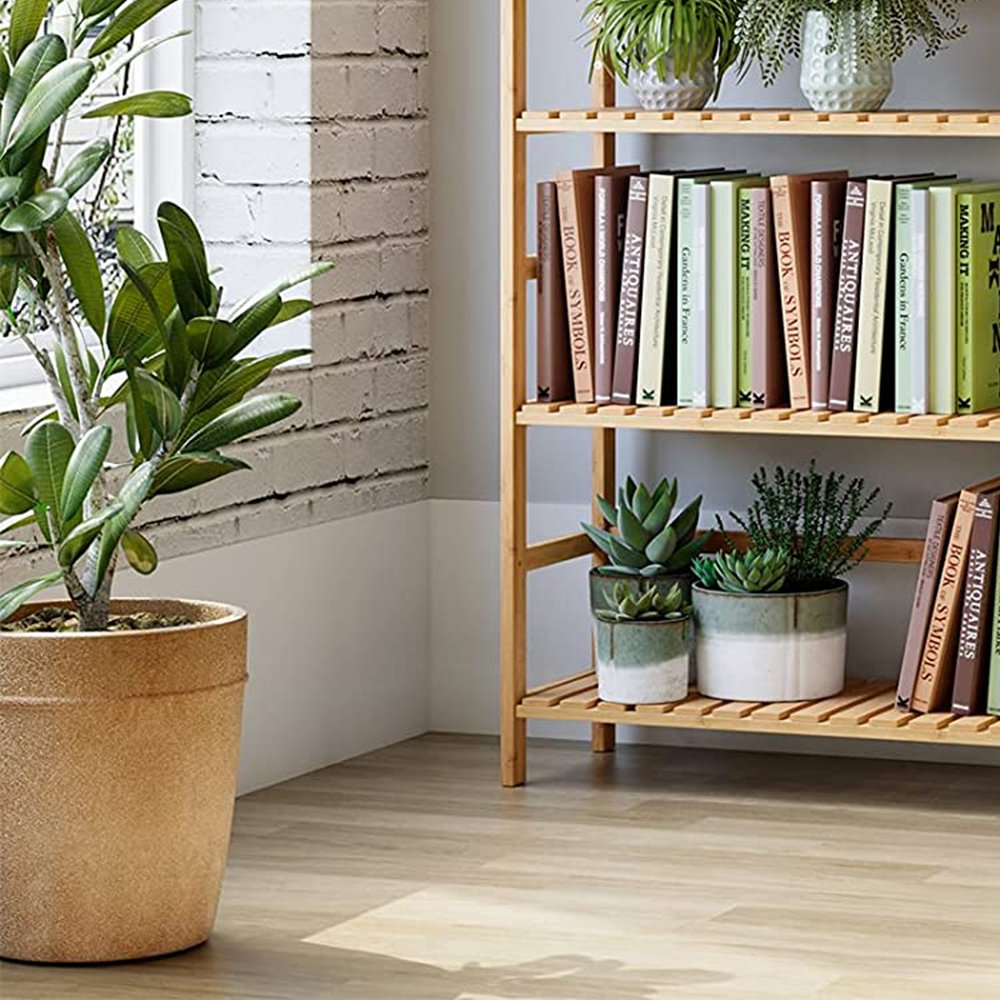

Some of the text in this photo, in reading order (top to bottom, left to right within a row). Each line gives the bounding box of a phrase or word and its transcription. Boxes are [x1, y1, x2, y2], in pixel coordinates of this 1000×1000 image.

[563, 225, 578, 272] BOOK
[741, 199, 751, 252] MAKING
[741, 256, 751, 270] IT
[778, 231, 793, 278] BOOK
[959, 204, 969, 258] MAKING
[622, 233, 643, 347] ANTIQUAIRES
[681, 247, 691, 345] Gardens in France
[840, 239, 861, 353] ANTIQUAIRES
[899, 252, 910, 350] Gardens in France
[959, 262, 969, 276] IT
[570, 289, 587, 371] SYMBOLS
[784, 295, 803, 377] SYMBOLS
[943, 543, 963, 587] BOOK
[964, 550, 987, 659] ANTIQUAIRES
[922, 603, 949, 682] SYMBOLS
